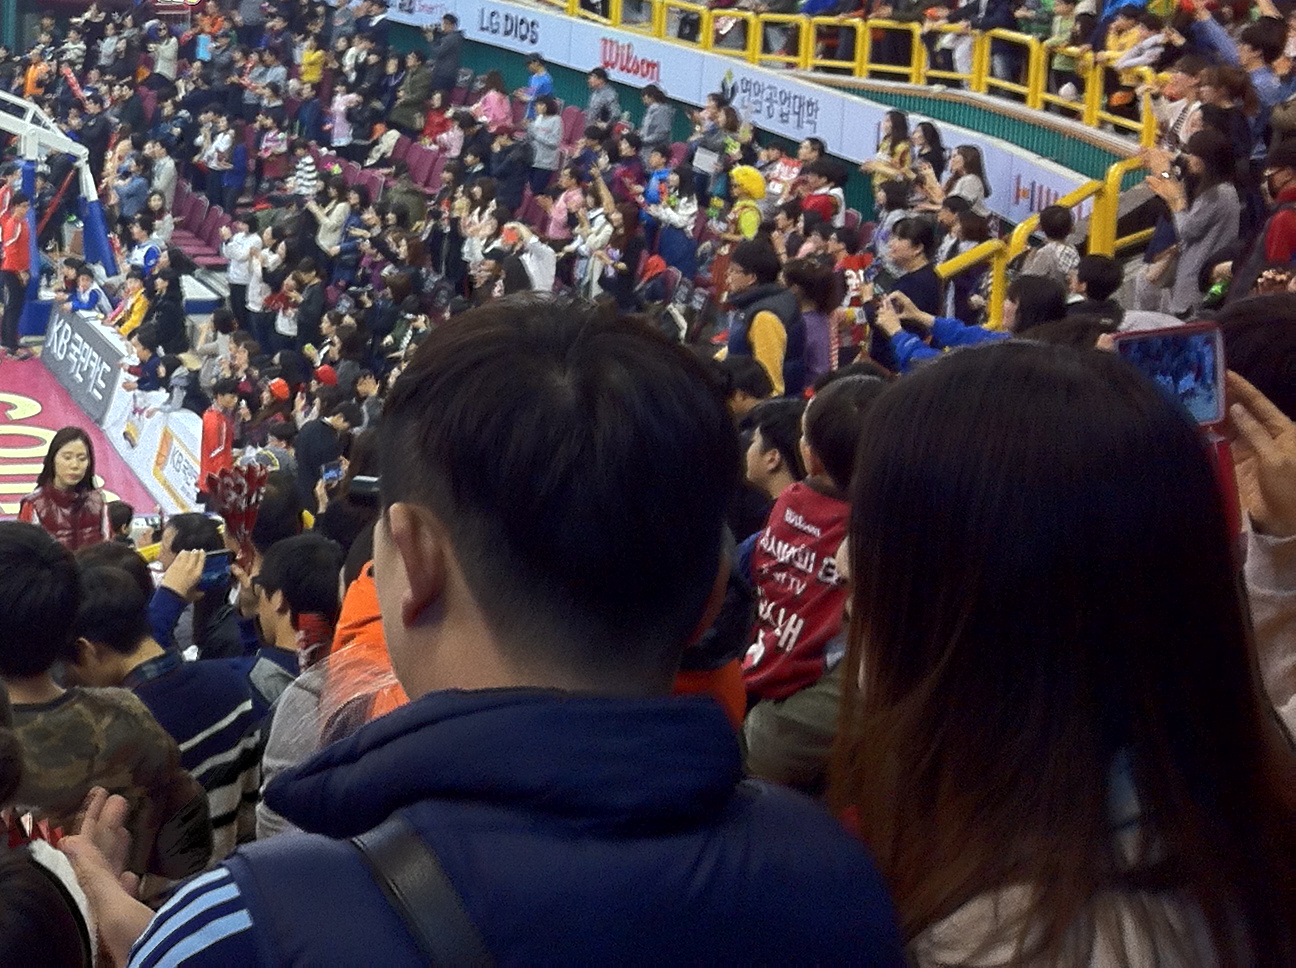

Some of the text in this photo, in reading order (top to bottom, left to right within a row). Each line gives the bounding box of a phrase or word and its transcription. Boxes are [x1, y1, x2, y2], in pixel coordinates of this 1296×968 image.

[478, 6, 540, 45] LG DIOS
[600, 36, 662, 84] Wilson
